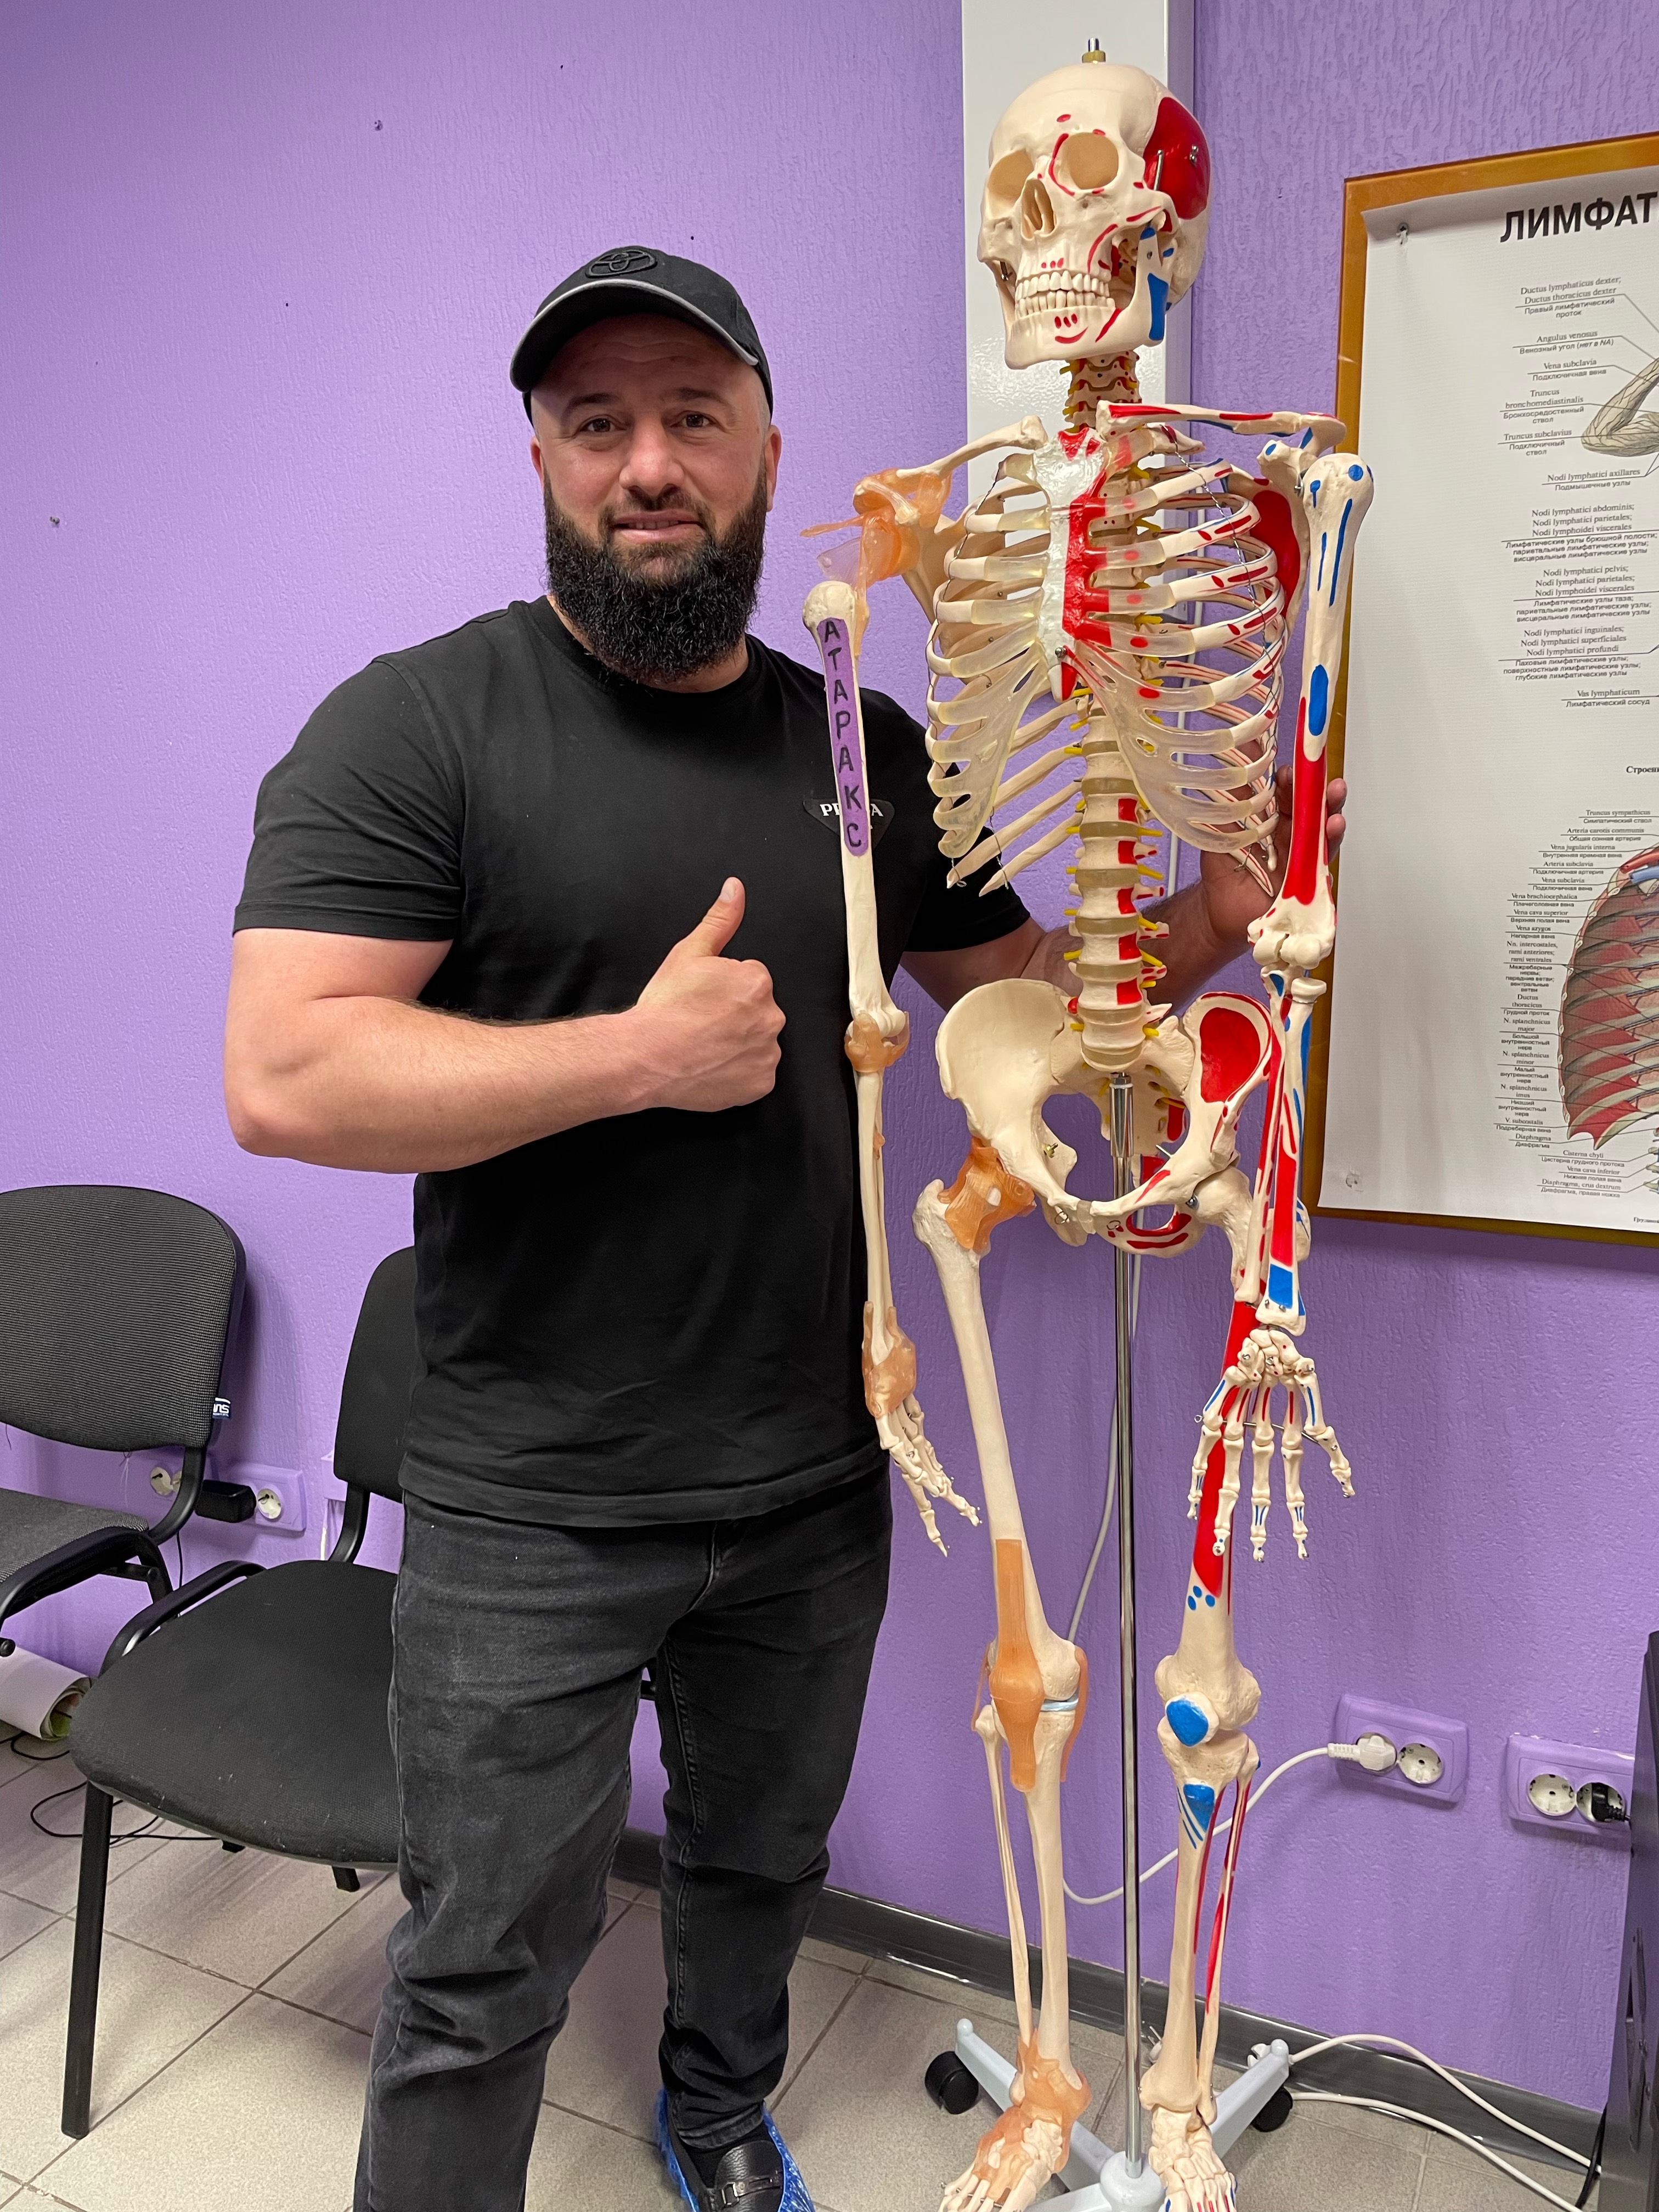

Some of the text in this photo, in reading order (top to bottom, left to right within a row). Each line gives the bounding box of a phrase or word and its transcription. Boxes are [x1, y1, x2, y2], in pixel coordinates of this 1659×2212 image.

[1549, 280, 1593, 292] lymphaticus
[1553, 290, 1590, 300] thoracicus
[1593, 287, 1617, 296] dexter
[1537, 334, 1567, 343] Angulus
[1563, 359, 1596, 368] subclavia
[1505, 396, 1583, 409] bronchomediastinalis
[1534, 429, 1572, 438] subclavius
[1568, 470, 1607, 481] lymphatici
[1531, 508, 1550, 517] Nodi
[1552, 506, 1591, 516] lymphatici
[1532, 519, 1551, 527] Nodi
[1553, 516, 1592, 525] lymphatici
[1553, 527, 1594, 535] lymphoidei
[1564, 566, 1602, 575] lymphatici
[1536, 579, 1554, 587] Nodi
[1556, 577, 1595, 586] lymphatici
[1556, 587, 1596, 596] lymphoidei
[1544, 627, 1583, 636] lymphatici
[1541, 637, 1579, 646] lymphatici
[1581, 635, 1627, 644] superficiales
[1547, 646, 1584, 656] lymphatici
[1591, 689, 1640, 698] lymphaticum
[824, 620, 862, 848] АТАРАКС
[1626, 766, 1659, 774] Строен
